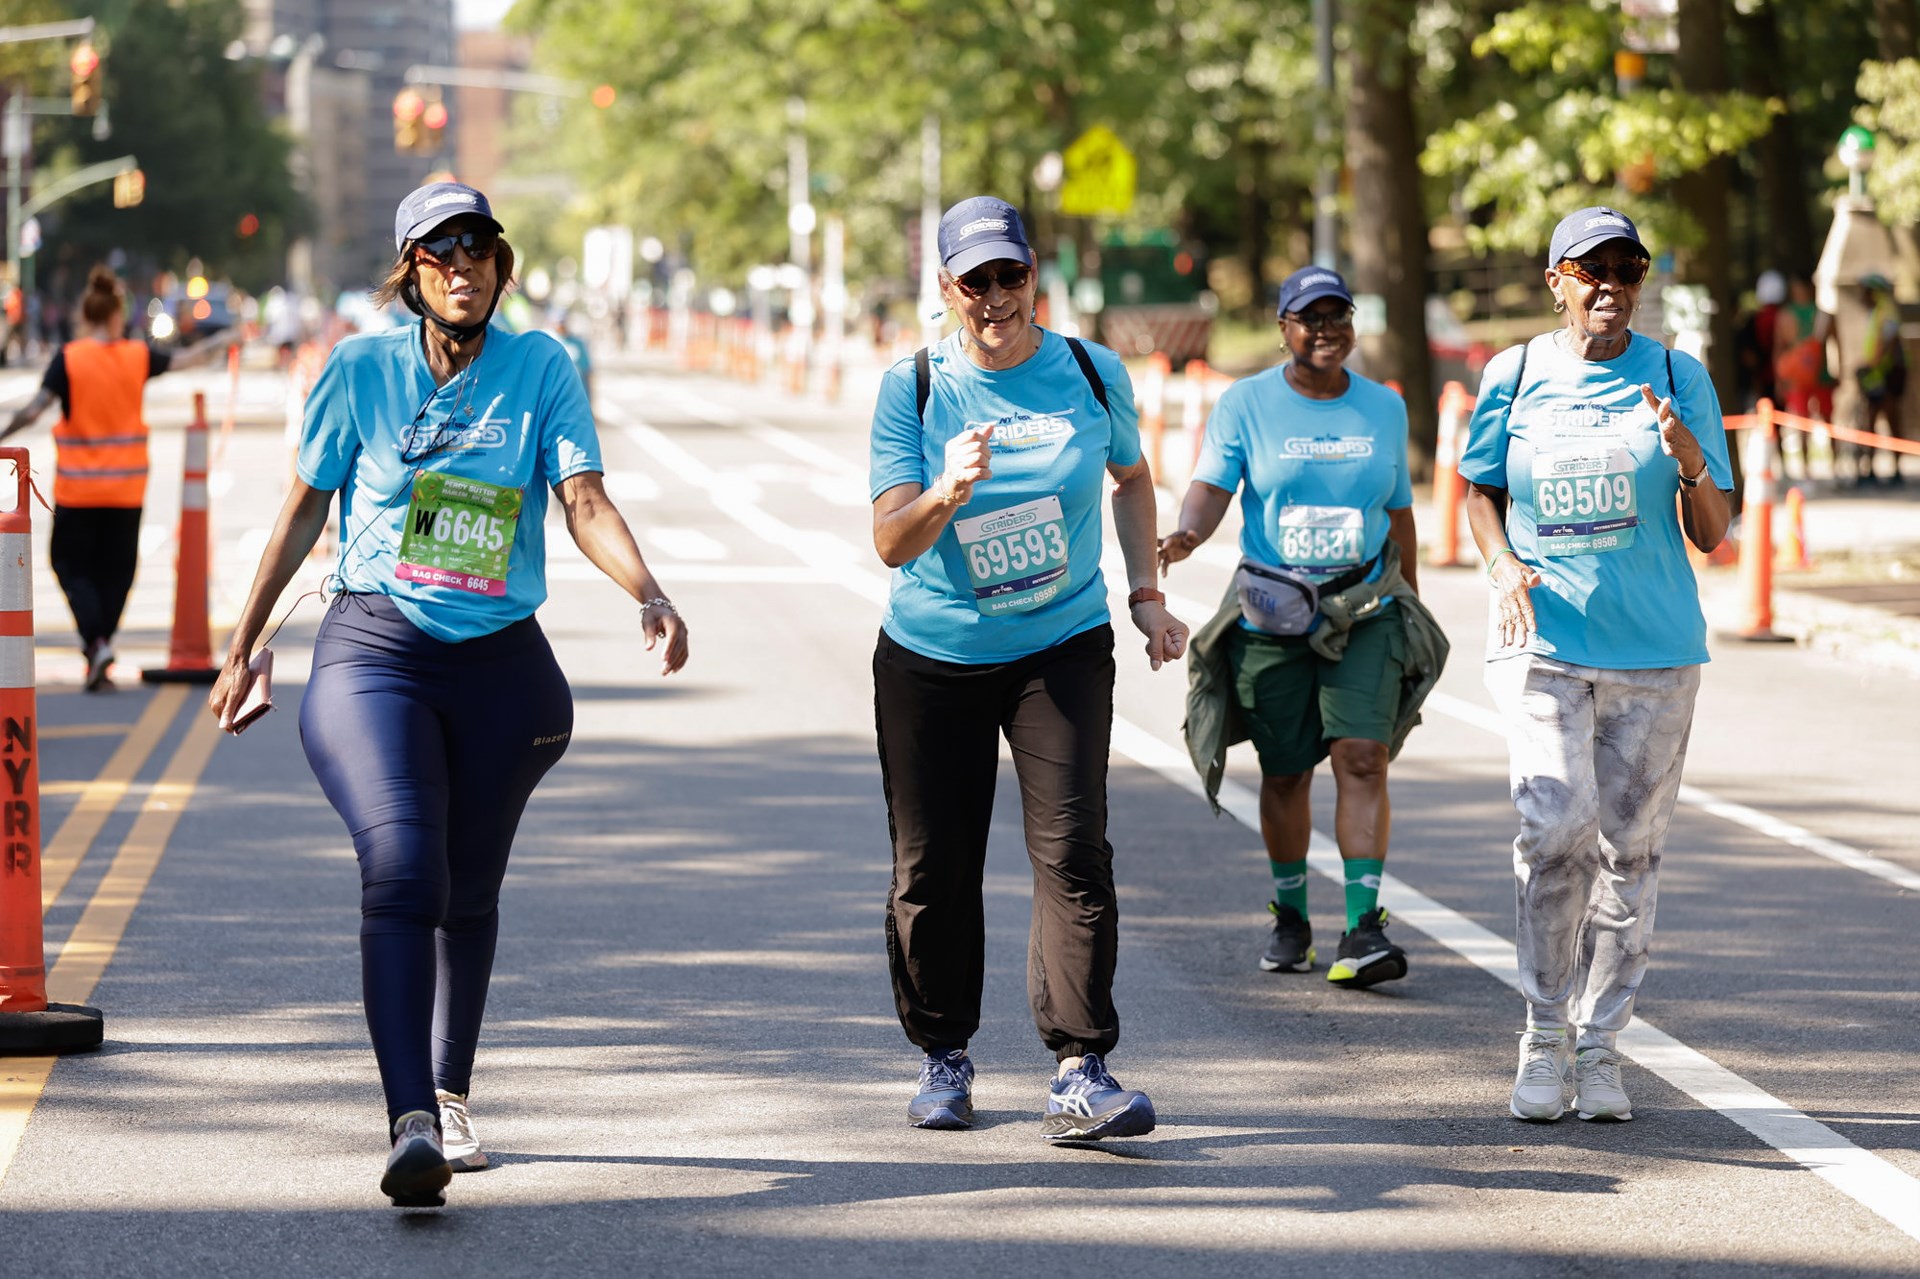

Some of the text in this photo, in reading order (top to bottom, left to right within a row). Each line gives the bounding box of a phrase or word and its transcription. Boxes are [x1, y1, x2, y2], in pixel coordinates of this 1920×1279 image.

[1292, 441, 1367, 454] STRIDERS
[1557, 461, 1605, 472] STRIDERS
[444, 480, 498, 497] PERCY SUTTON
[1539, 475, 1631, 517] 69509
[983, 512, 1034, 532] STRIDERS
[969, 522, 1066, 579] 69593
[1567, 541, 1592, 549] CHECK
[1592, 535, 1618, 549] 69509
[412, 569, 489, 591] BAG CHECK 6645
[992, 584, 1057, 611] BAG CHECK 69593
[3, 717, 32, 877] NYRR
